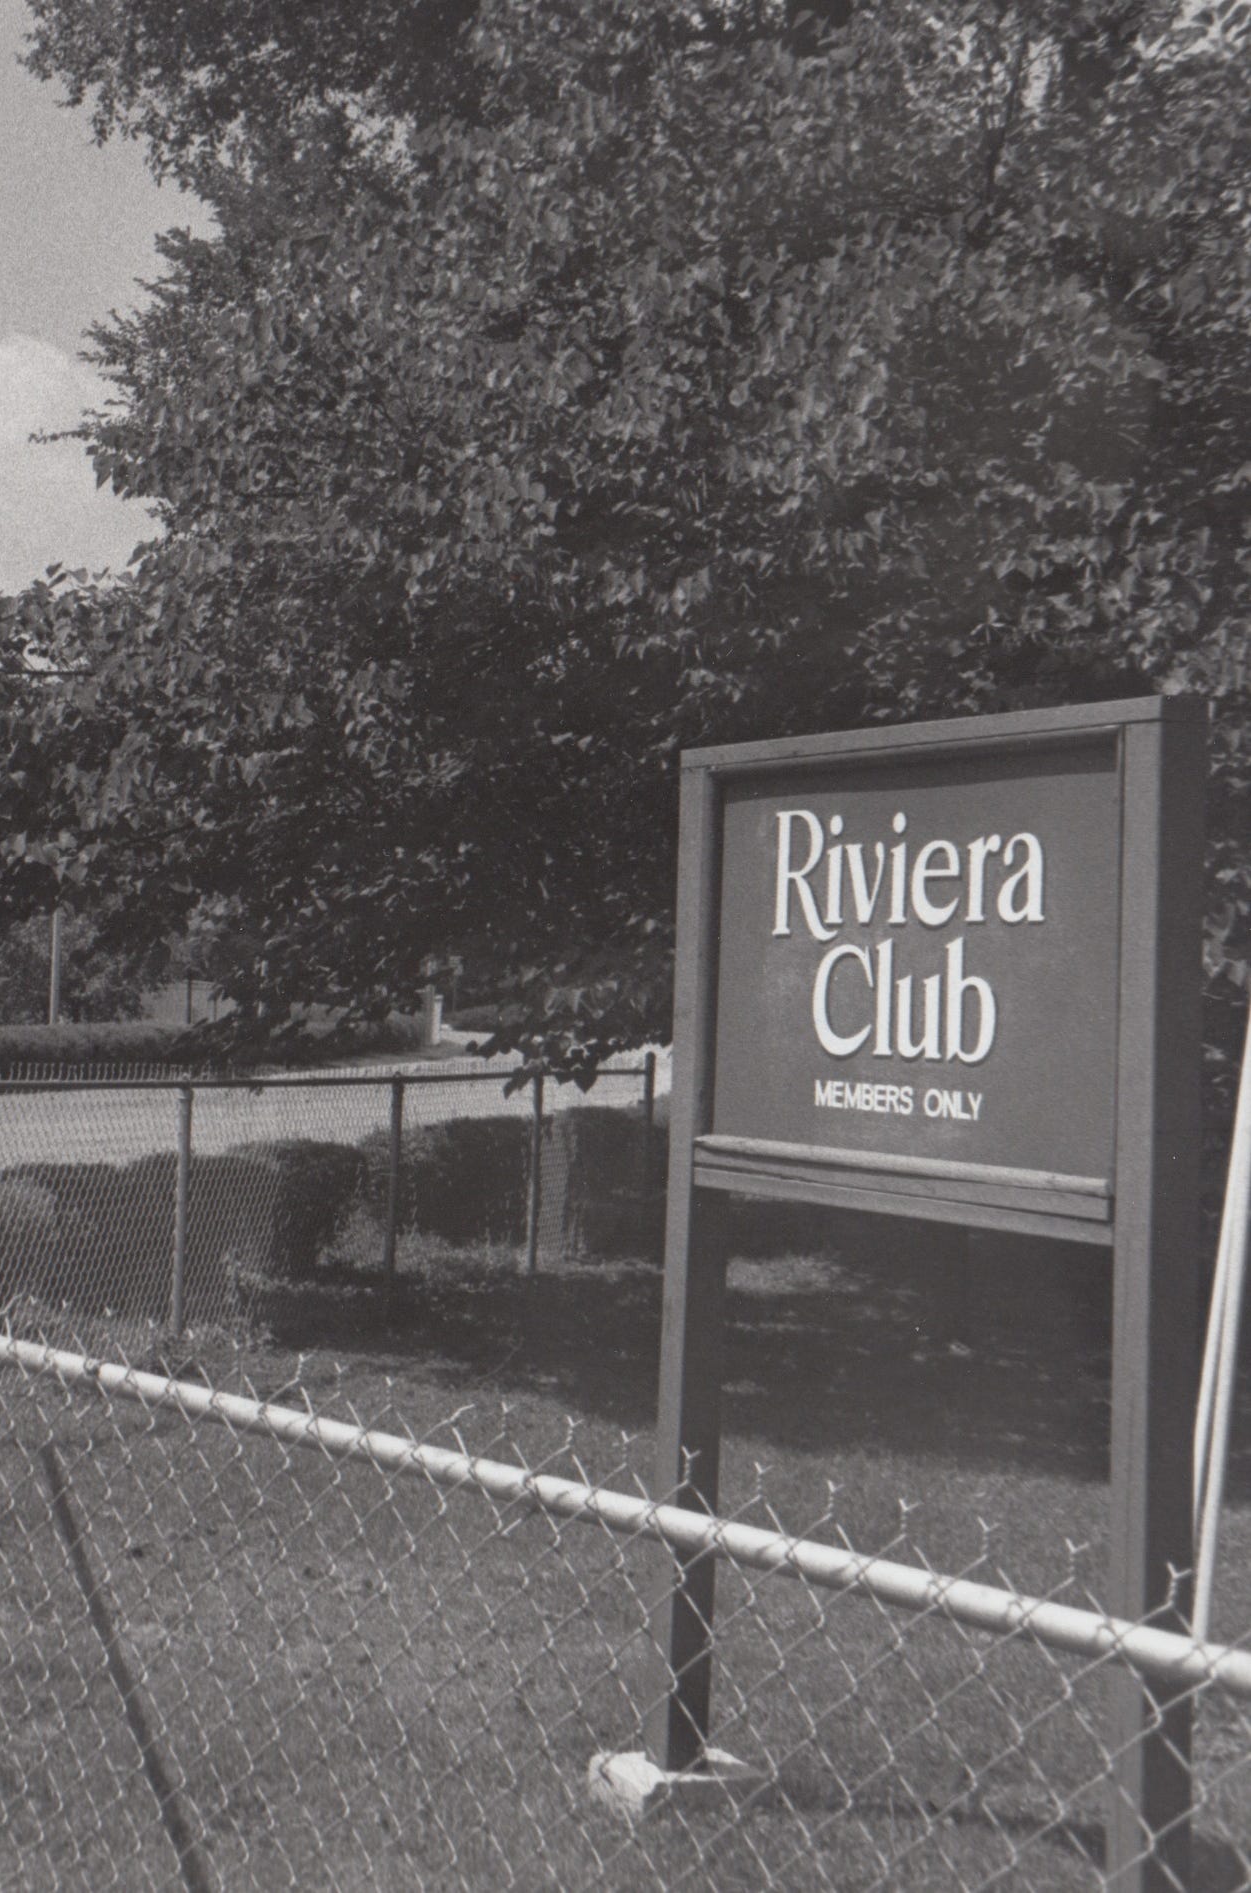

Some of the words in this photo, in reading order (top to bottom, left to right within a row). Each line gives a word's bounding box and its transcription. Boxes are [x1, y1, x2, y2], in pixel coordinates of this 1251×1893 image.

[770, 808, 1046, 942] Riviera
[811, 936, 997, 1063] Club
[813, 1078, 915, 1116] MEMBERS
[922, 1087, 984, 1121] ONLY
